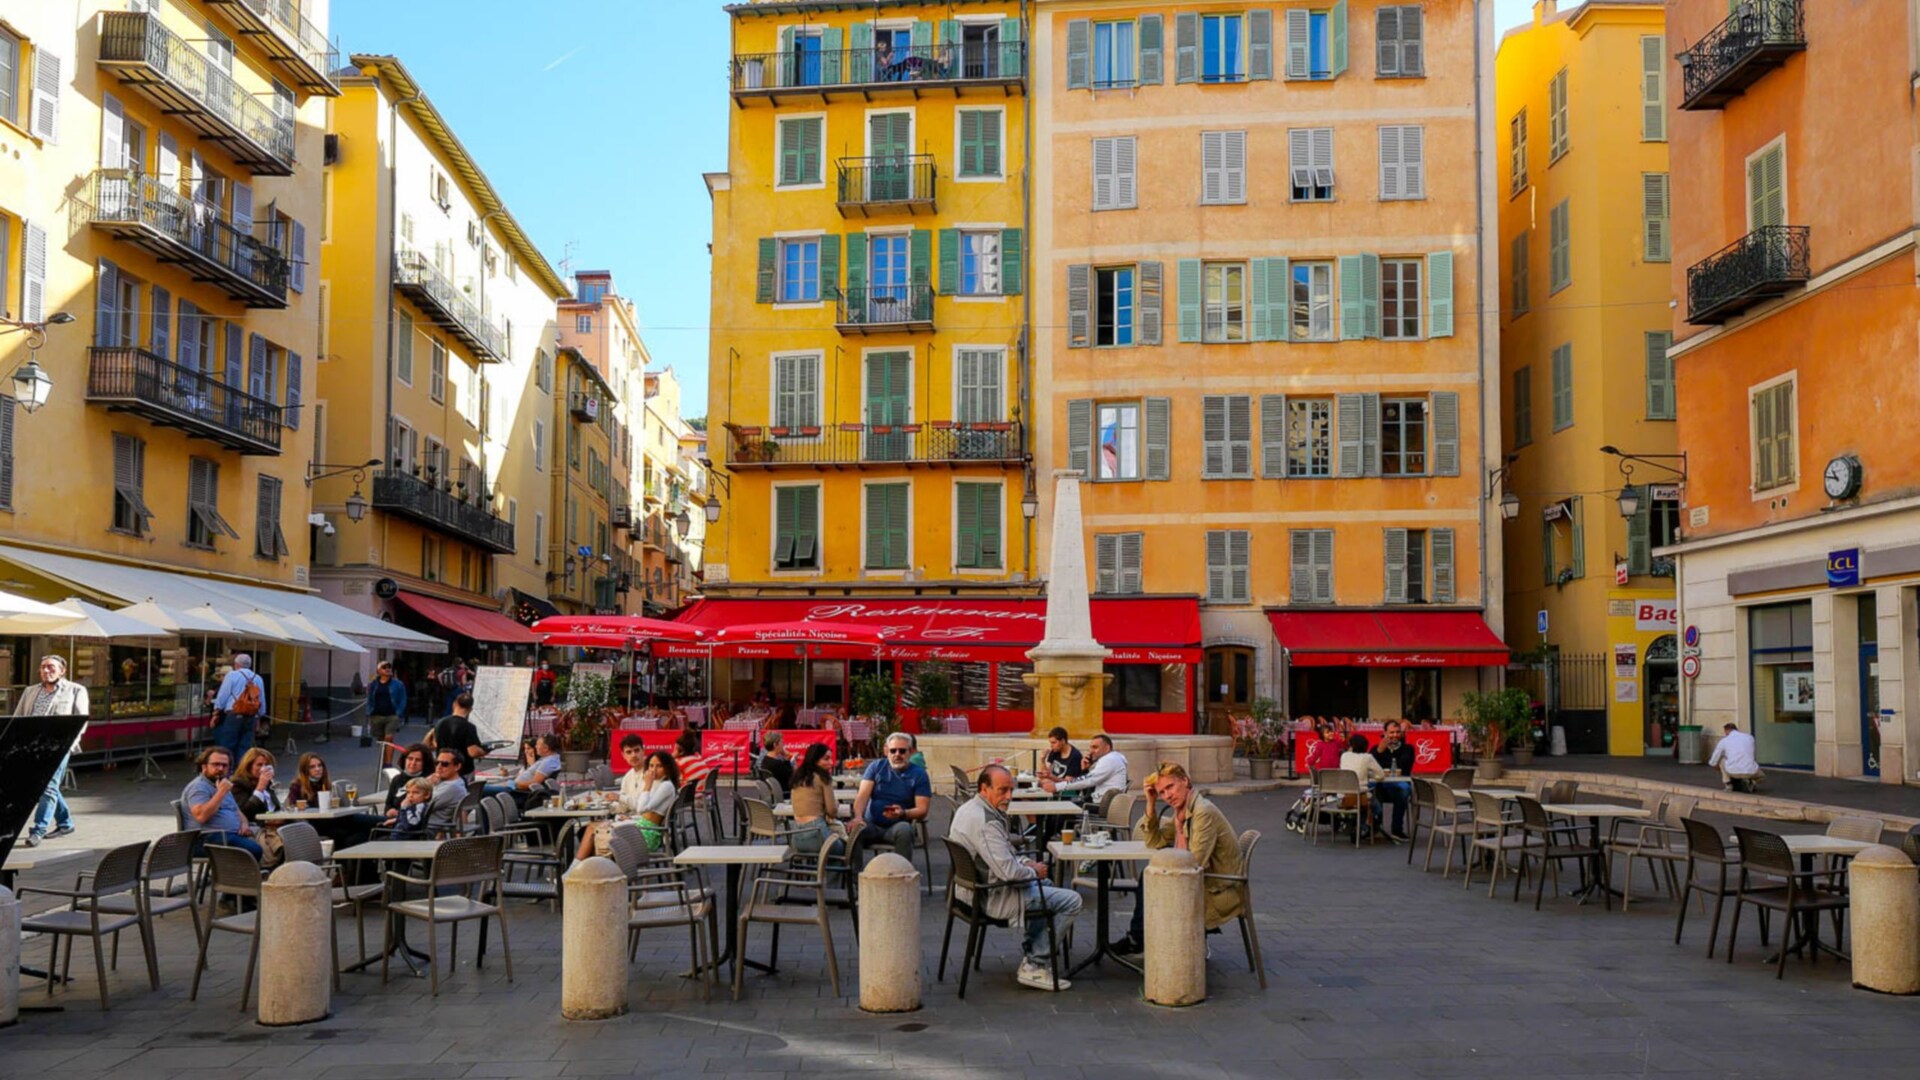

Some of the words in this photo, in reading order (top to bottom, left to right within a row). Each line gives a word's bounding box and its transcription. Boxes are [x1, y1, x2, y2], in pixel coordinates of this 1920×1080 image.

[1827, 557, 1855, 571] LCL
[808, 604, 1046, 620] Restauran
[809, 629, 847, 640] Niçoises
[738, 646, 769, 655] Pizzeria
[1148, 651, 1182, 661] Niçoises
